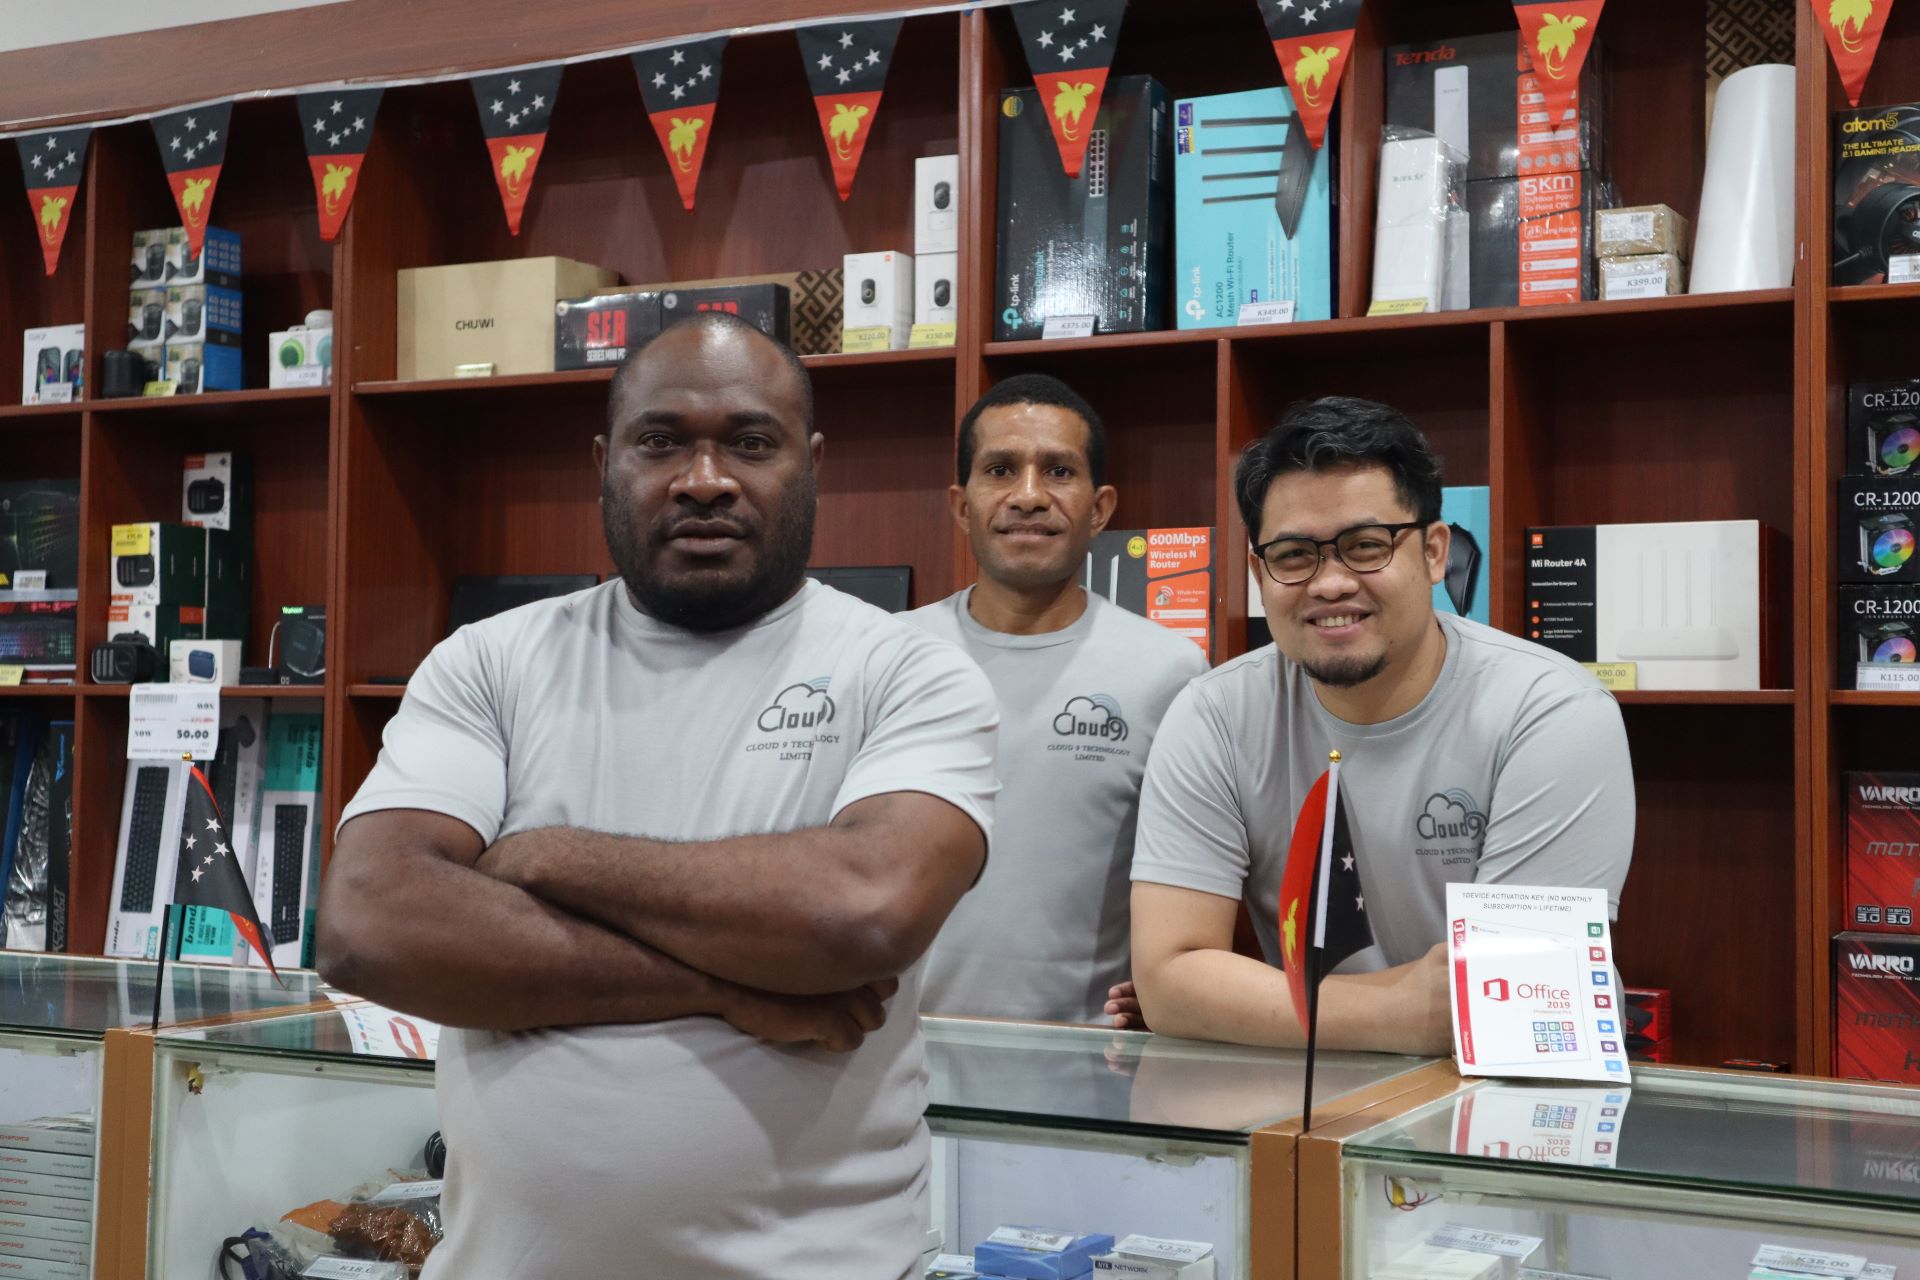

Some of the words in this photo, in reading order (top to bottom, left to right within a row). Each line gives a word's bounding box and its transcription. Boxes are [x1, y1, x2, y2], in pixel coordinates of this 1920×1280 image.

[1395, 45, 1456, 66] Tenda
[1861, 139, 1904, 149] ULTIMATE
[1855, 147, 1887, 157] GAMING
[1226, 232, 1235, 263] Router
[1191, 266, 1202, 298] tp-link
[1627, 276, 1663, 287] K399.00
[1010, 273, 1021, 307] tp-link
[1216, 281, 1224, 318] AC1200
[455, 318, 495, 331] CHUWI
[1061, 321, 1091, 330] K375.00
[1854, 491, 1920, 506] CR-1200
[1150, 532, 1207, 547] 600Mbps
[1150, 550, 1187, 559] Wireless
[1190, 550, 1197, 558] N
[1150, 560, 1180, 568] Router
[1531, 559, 1543, 568] Mi
[1544, 559, 1573, 567] Router
[1574, 558, 1587, 567] 4A
[1854, 599, 1920, 614] CR-1200
[1880, 673, 1919, 682] K115.00
[1053, 712, 1128, 741] Cloud9
[177, 729, 209, 740] 50.00
[746, 742, 779, 752] CLOUD
[791, 735, 840, 749] TECHLOGY
[1859, 785, 1920, 806] VARRO
[1416, 813, 1487, 840] Cloud9
[1866, 841, 1920, 857] MOT
[185, 906, 199, 944] band
[1858, 913, 1880, 923] 3.0
[1888, 914, 1911, 925] 3.0
[1848, 953, 1914, 976] VARRO
[1517, 984, 1570, 1000] Office
[1547, 1001, 1571, 1009] 2019
[1114, 1264, 1149, 1273] NETWORK
[1795, 1256, 1850, 1268] K38.00
